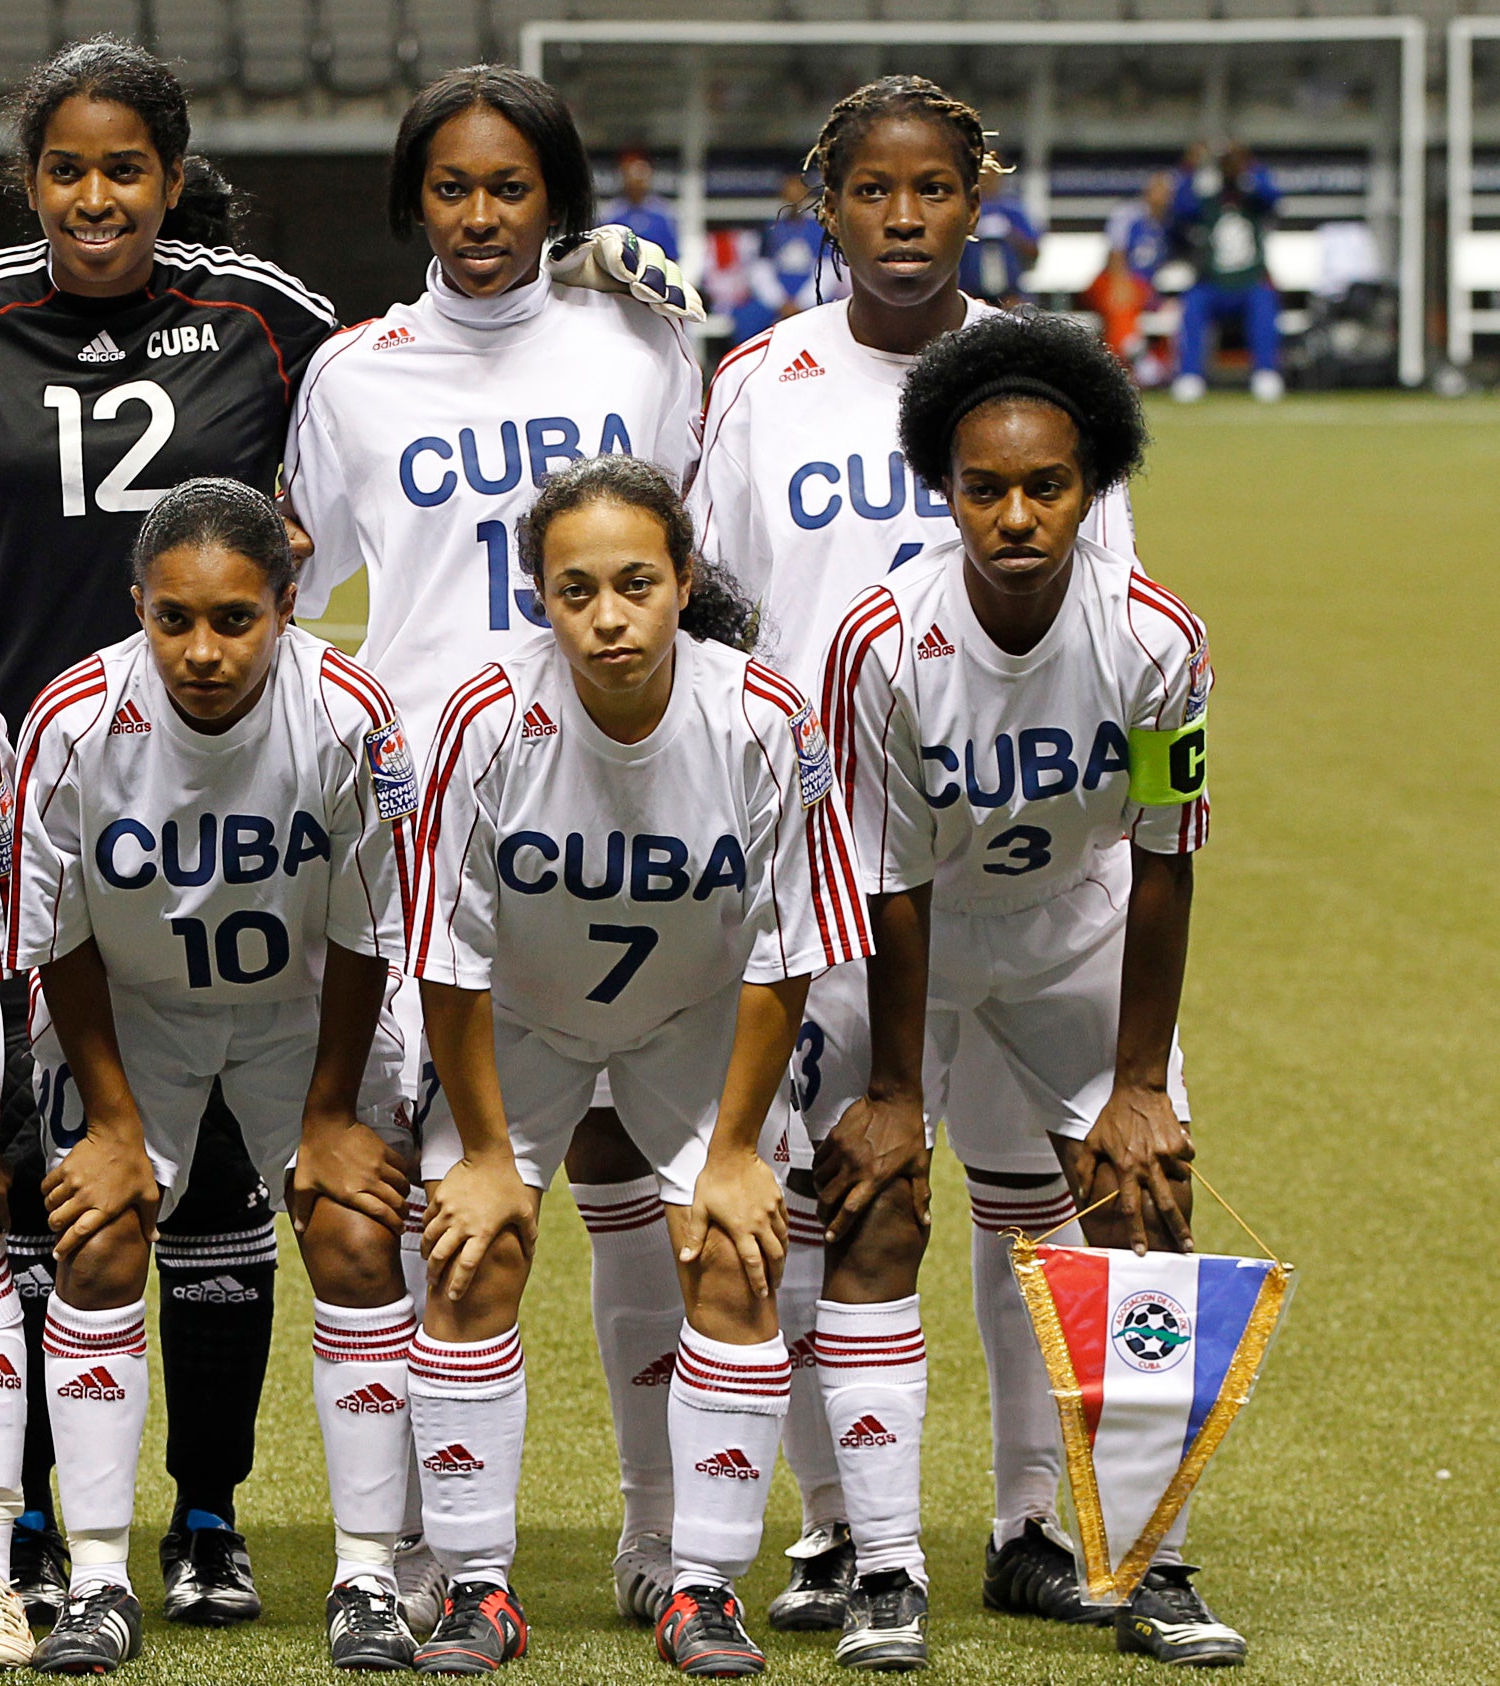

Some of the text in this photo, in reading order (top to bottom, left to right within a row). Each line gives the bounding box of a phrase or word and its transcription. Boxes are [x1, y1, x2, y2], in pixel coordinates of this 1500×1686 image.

[146, 323, 219, 360] CUBA
[371, 335, 416, 351] adidas
[77, 348, 126, 362] adidas
[778, 365, 826, 382] adidas
[43, 379, 176, 517] 12
[108, 722, 152, 736] didas
[1169, 728, 1205, 794] C
[96, 810, 331, 890] CUBA
[982, 824, 1052, 876] 3
[497, 830, 747, 902] CUBA
[172, 910, 289, 989] 10
[585, 923, 659, 1004] 7
[38, 1063, 87, 1149] 10
[172, 1284, 259, 1303] adidas
[1157, 1296, 1168, 1306] DE
[1138, 1360, 1162, 1370] CUBA
[57, 1384, 126, 1401] adidas
[335, 1396, 406, 1414] adidas
[839, 1431, 897, 1448] adidas
[423, 1457, 485, 1473] adidas
[695, 1460, 760, 1481] adidas
